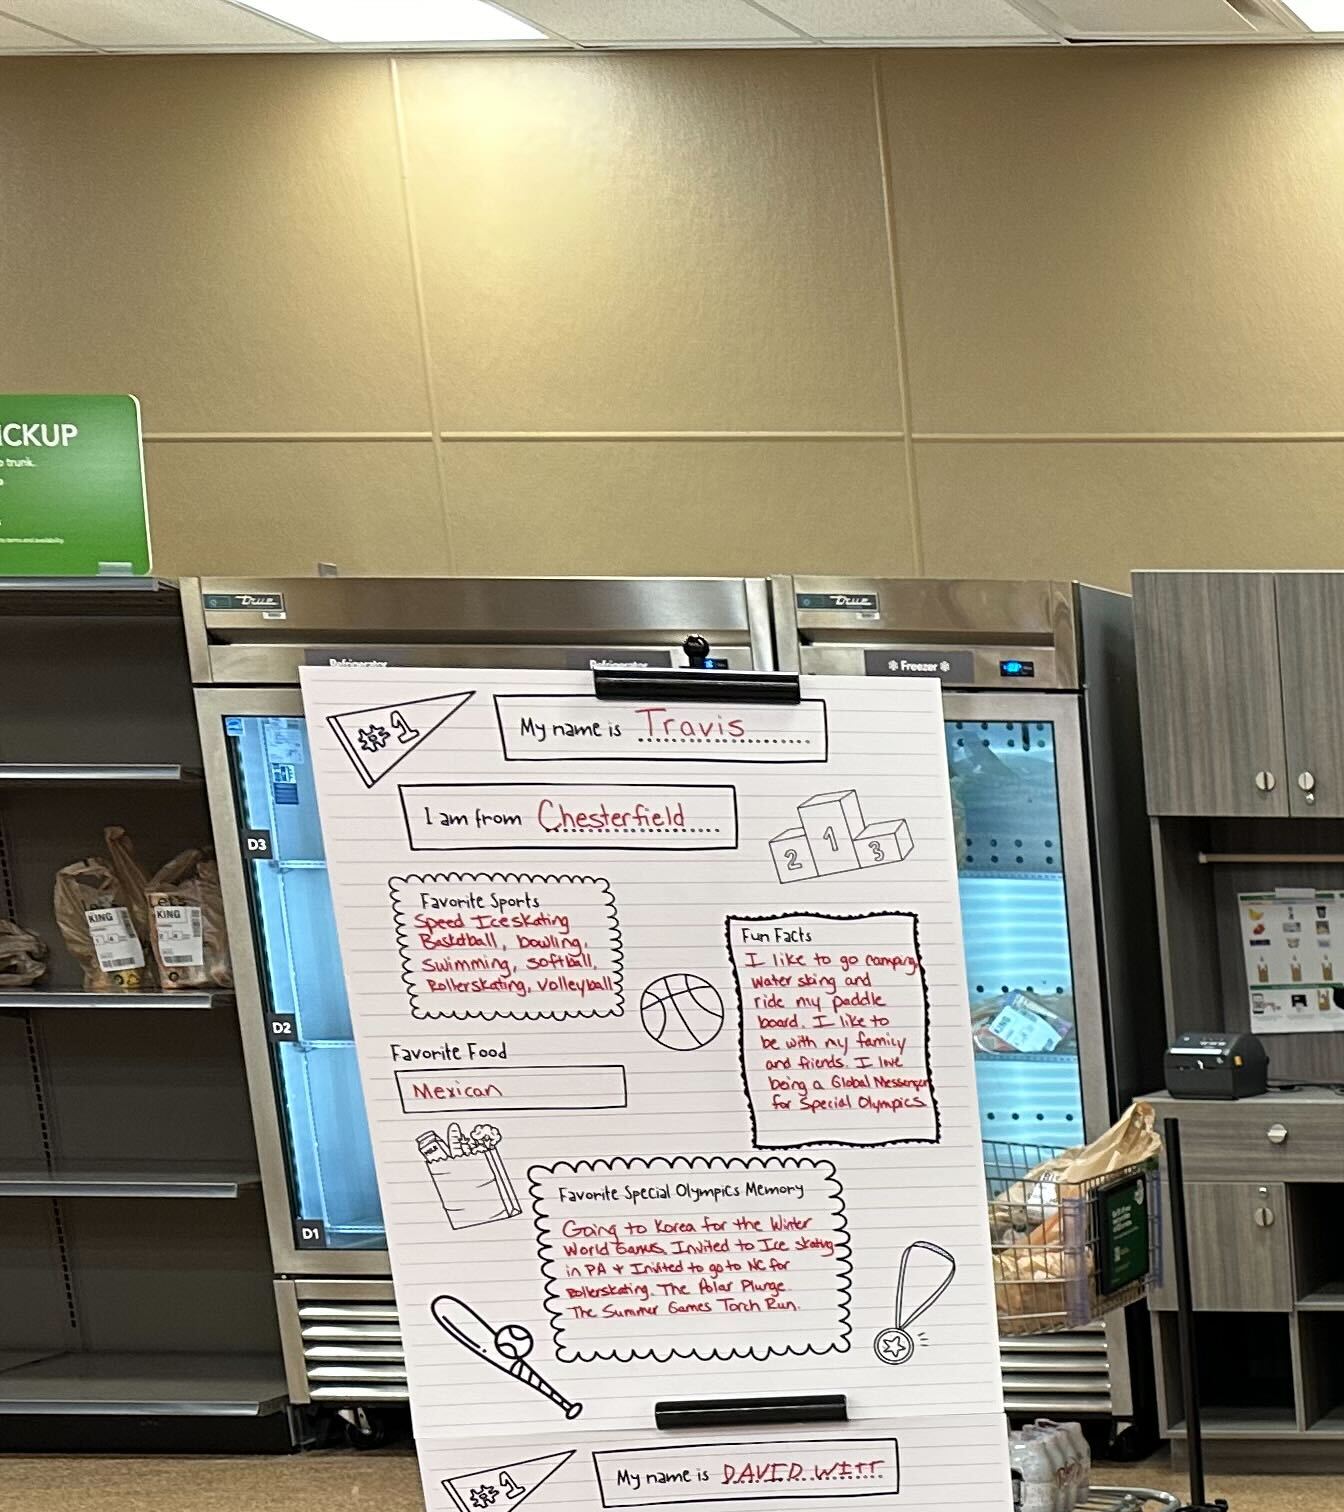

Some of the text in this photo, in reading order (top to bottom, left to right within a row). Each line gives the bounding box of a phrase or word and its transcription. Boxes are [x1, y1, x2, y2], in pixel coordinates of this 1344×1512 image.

[901, 661, 938, 671] Freezer
[521, 706, 746, 742] My name is Travis
[424, 799, 686, 831] I am from Chesterfield
[247, 838, 267, 851] D3
[420, 892, 540, 914] Favorite Sports
[88, 912, 113, 923] KING
[157, 909, 181, 919] KING
[741, 926, 813, 943] Fun Facts
[744, 952, 859, 972] I like to go
[844, 972, 872, 987] and
[753, 992, 887, 1013] ride my paddle
[272, 1021, 292, 1035] D2
[812, 1013, 890, 1028] I like to
[760, 1035, 816, 1050] be with
[390, 1041, 508, 1062] Favorite Food
[766, 1057, 792, 1070] and
[412, 1080, 503, 1099] Mexican
[771, 1094, 792, 1109] for
[799, 1094, 852, 1114] Special
[558, 1181, 805, 1205] Favorite Special Olympics Memory
[302, 1226, 320, 1240] D1
[624, 1221, 648, 1235] to
[654, 1219, 696, 1234] Korea
[702, 1215, 727, 1232] for
[733, 1215, 762, 1232] the
[735, 1238, 757, 1252] to
[688, 1262, 704, 1274] to
[656, 1282, 690, 1296] The
[566, 1297, 761, 1319] The Torch
[616, 1468, 641, 1489] My
[646, 1469, 691, 1484] name
[697, 1467, 710, 1482] is
